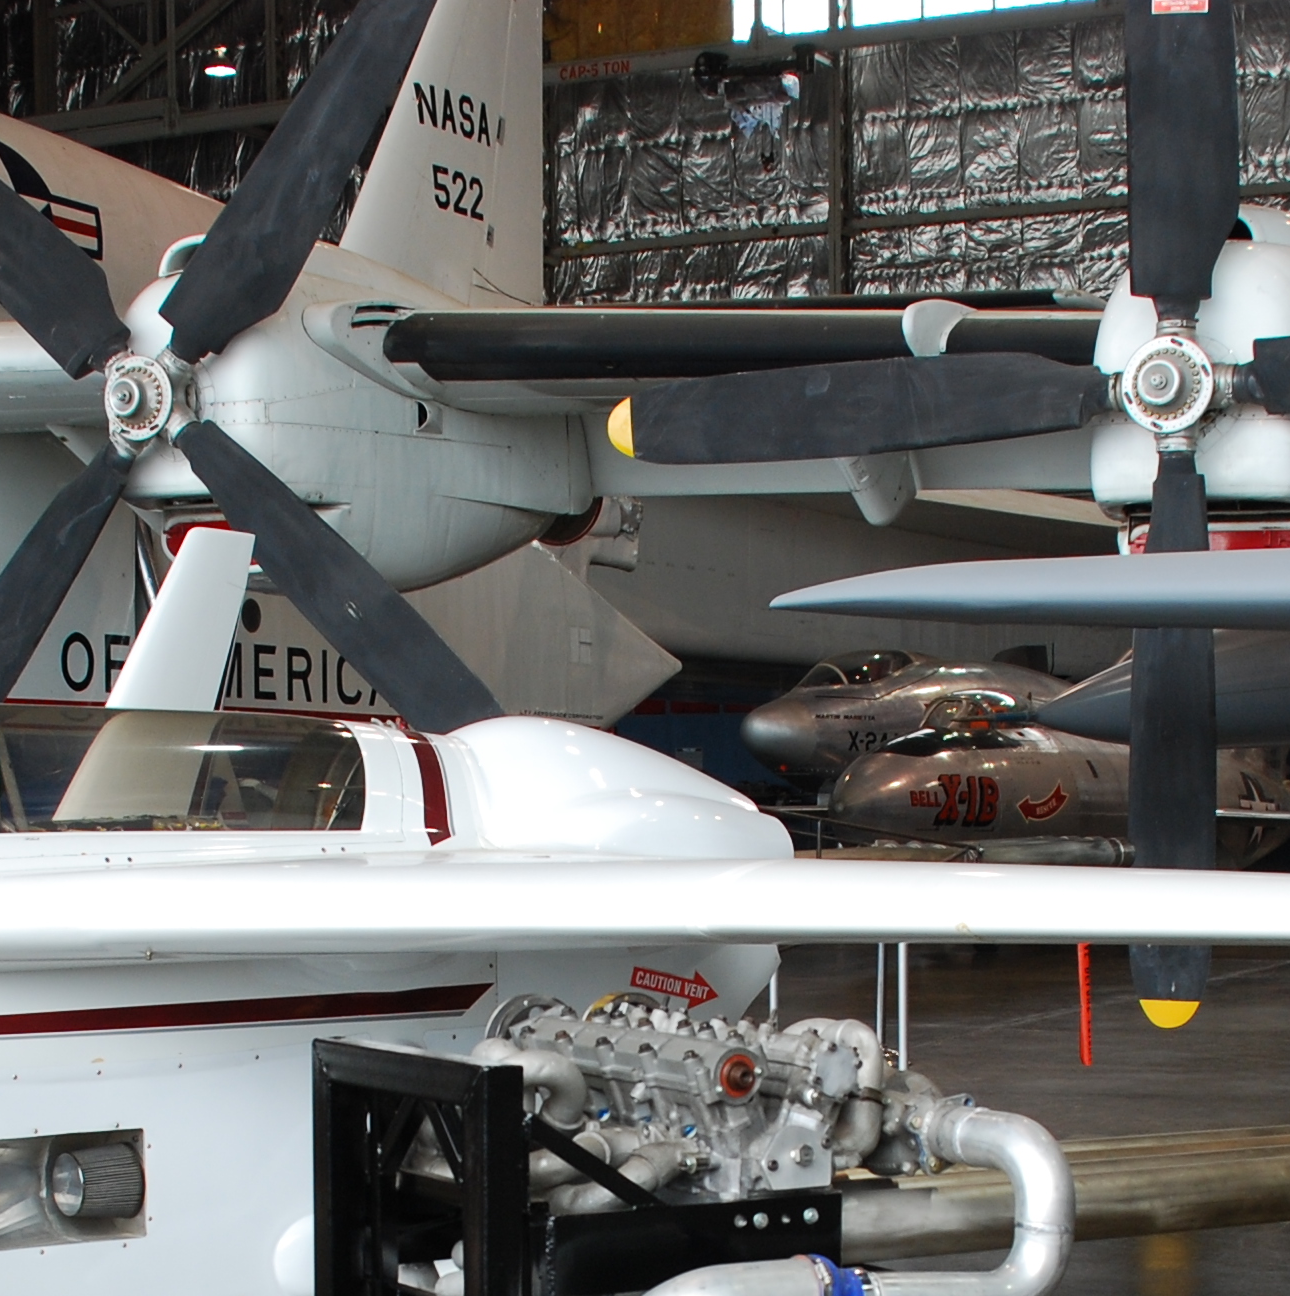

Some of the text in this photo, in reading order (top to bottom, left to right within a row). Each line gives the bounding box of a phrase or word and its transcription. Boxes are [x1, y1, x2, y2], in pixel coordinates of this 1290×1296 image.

[603, 60, 631, 75] TON
[413, 82, 491, 147] NASA
[432, 163, 484, 222] 522
[61, 631, 131, 693] OF
[909, 773, 1000, 827] BELL X-1B
[635, 970, 710, 1000] CAUTION VENT
